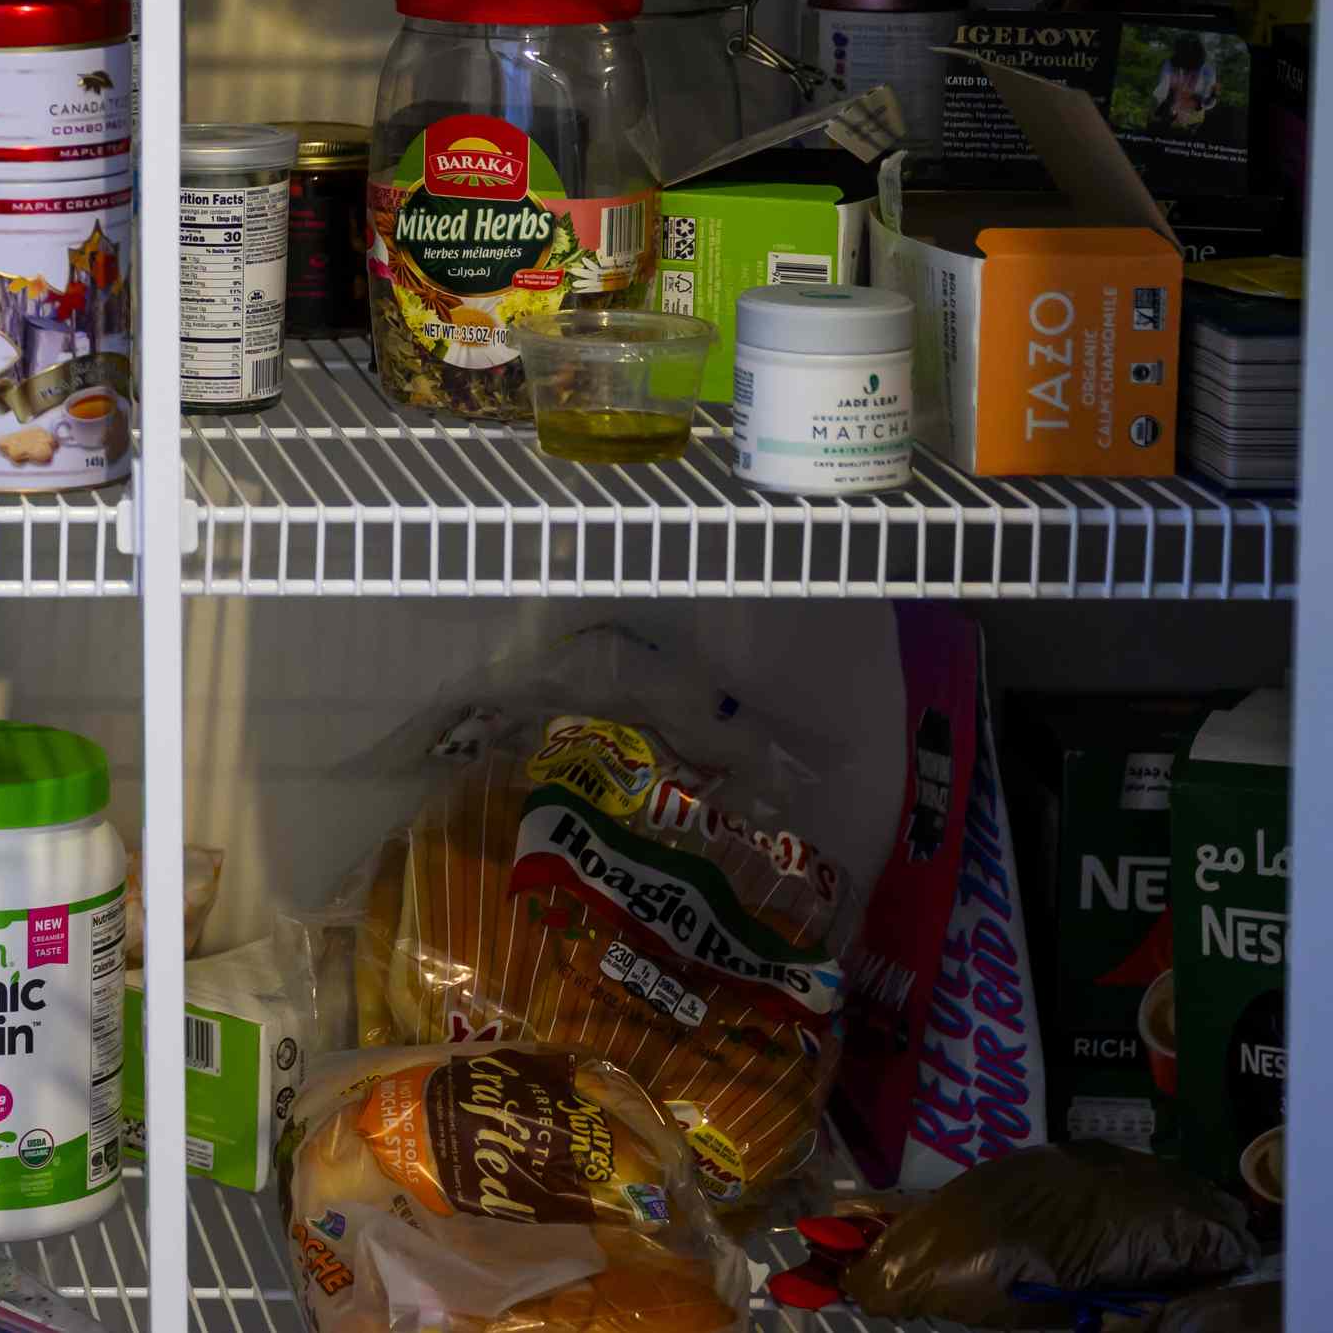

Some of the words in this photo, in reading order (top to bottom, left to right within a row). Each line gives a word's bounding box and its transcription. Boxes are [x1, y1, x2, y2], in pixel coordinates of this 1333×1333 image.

[954, 24, 1100, 47] IGELOW
[49, 100, 106, 117] CANADA
[51, 122, 103, 136] COMBO
[59, 146, 105, 159] MAPLE
[435, 153, 515, 177] BARAKA
[11, 201, 62, 213] MAPLE
[213, 192, 244, 205] Facts
[394, 209, 467, 244] Mixed
[472, 208, 554, 242] Herbs
[222, 231, 242, 245] 30
[423, 245, 459, 261] Herbes
[461, 244, 523, 261] mélangées
[423, 323, 441, 339] NET
[1099, 286, 1120, 396] CHAMOMILE
[1025, 291, 1075, 443] TAZO
[1083, 328, 1096, 406] ORGANIC
[836, 396, 869, 409] JADE
[873, 394, 899, 407] LEAF
[812, 422, 909, 442] MATCHA
[1097, 399, 1113, 450] CALM
[549, 811, 697, 941] Hoagie
[34, 917, 63, 933] NEW
[34, 947, 62, 957] TASTE
[1073, 1036, 1138, 1060] RICH
[459, 1055, 536, 1218] Crafted
